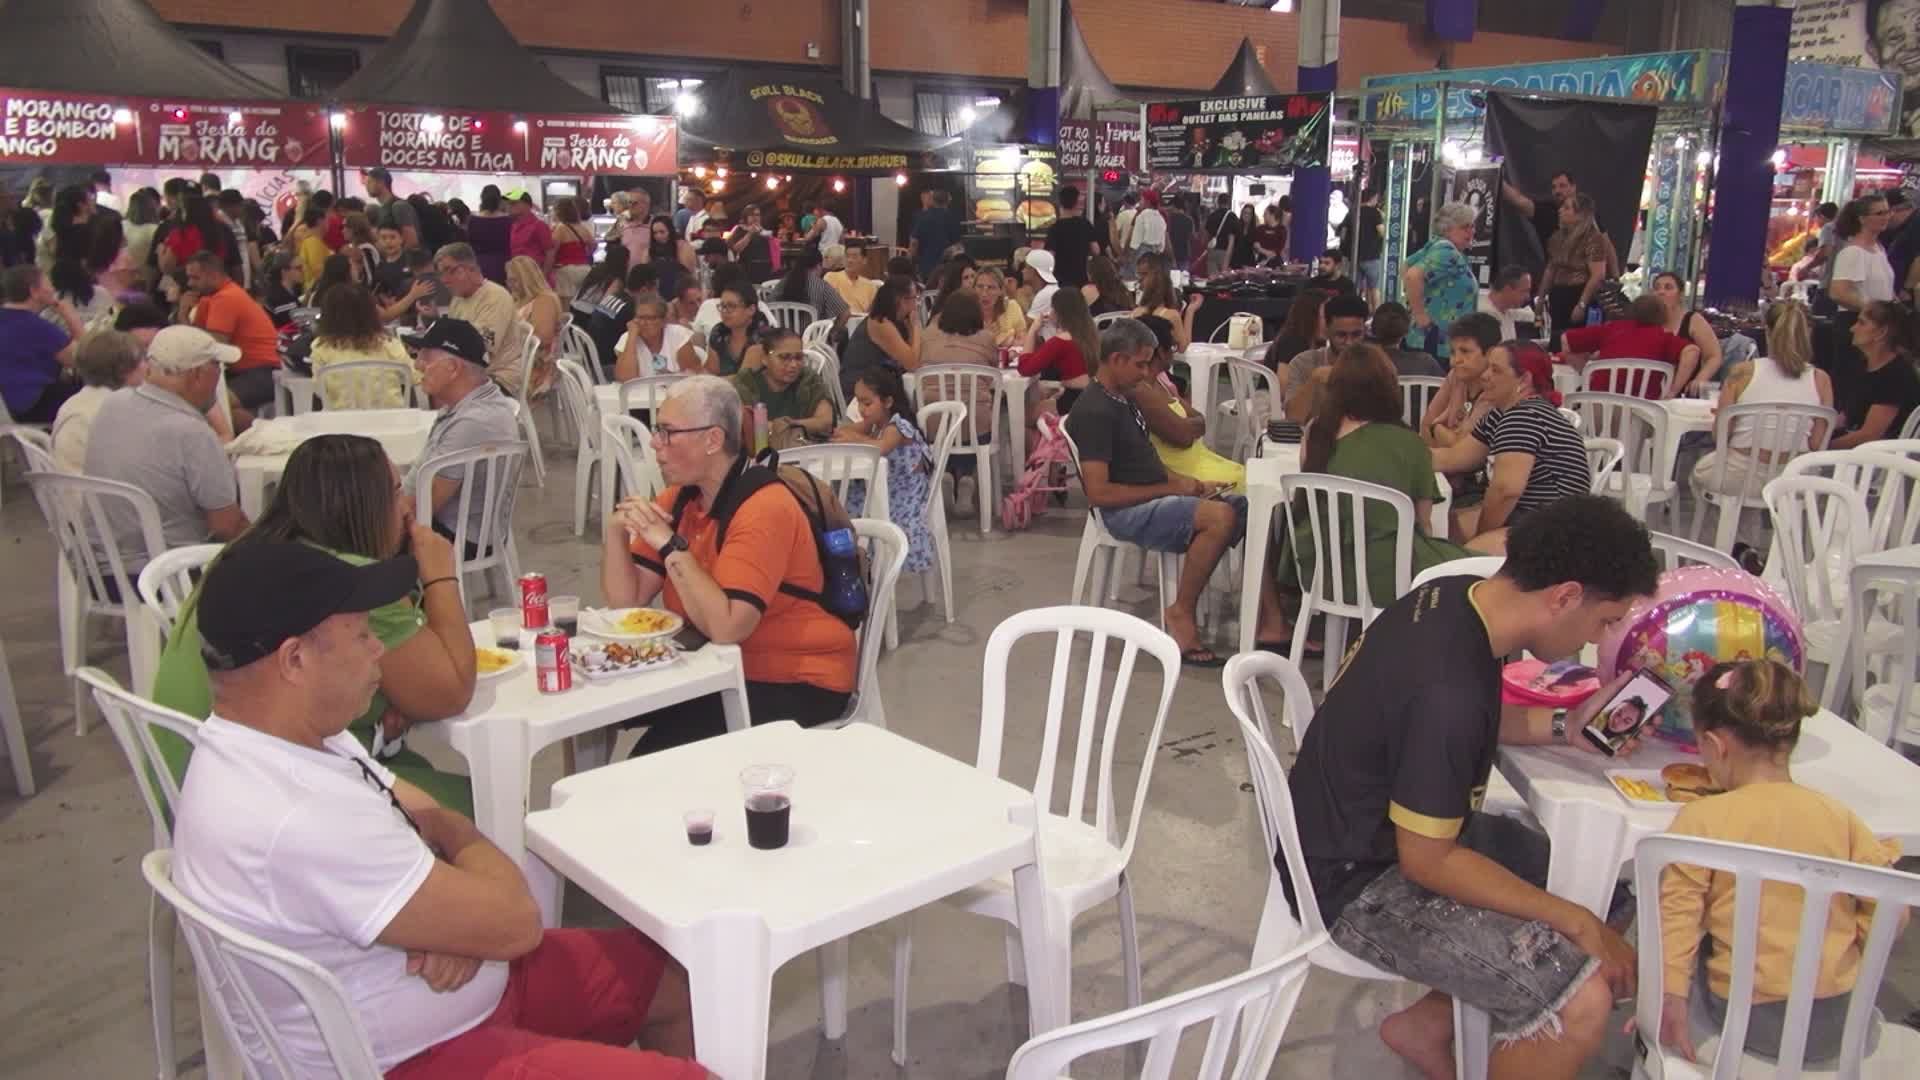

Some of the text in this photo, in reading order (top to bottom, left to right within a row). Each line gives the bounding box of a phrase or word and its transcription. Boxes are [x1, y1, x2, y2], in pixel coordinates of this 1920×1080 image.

[750, 85, 825, 105] SKULL BLACK
[1200, 97, 1267, 113] EXCLUSIVE
[449, 116, 472, 132] DE
[1182, 110, 1284, 125] OUTLET DAS PANELAS
[5, 118, 117, 140] E BOMBOM
[195, 119, 248, 137] Festa
[254, 120, 279, 137] do
[380, 131, 481, 150] MORANGO E
[569, 133, 608, 148] Festa
[613, 133, 632, 148] do
[381, 149, 514, 172] DOCES NA TAÇA
